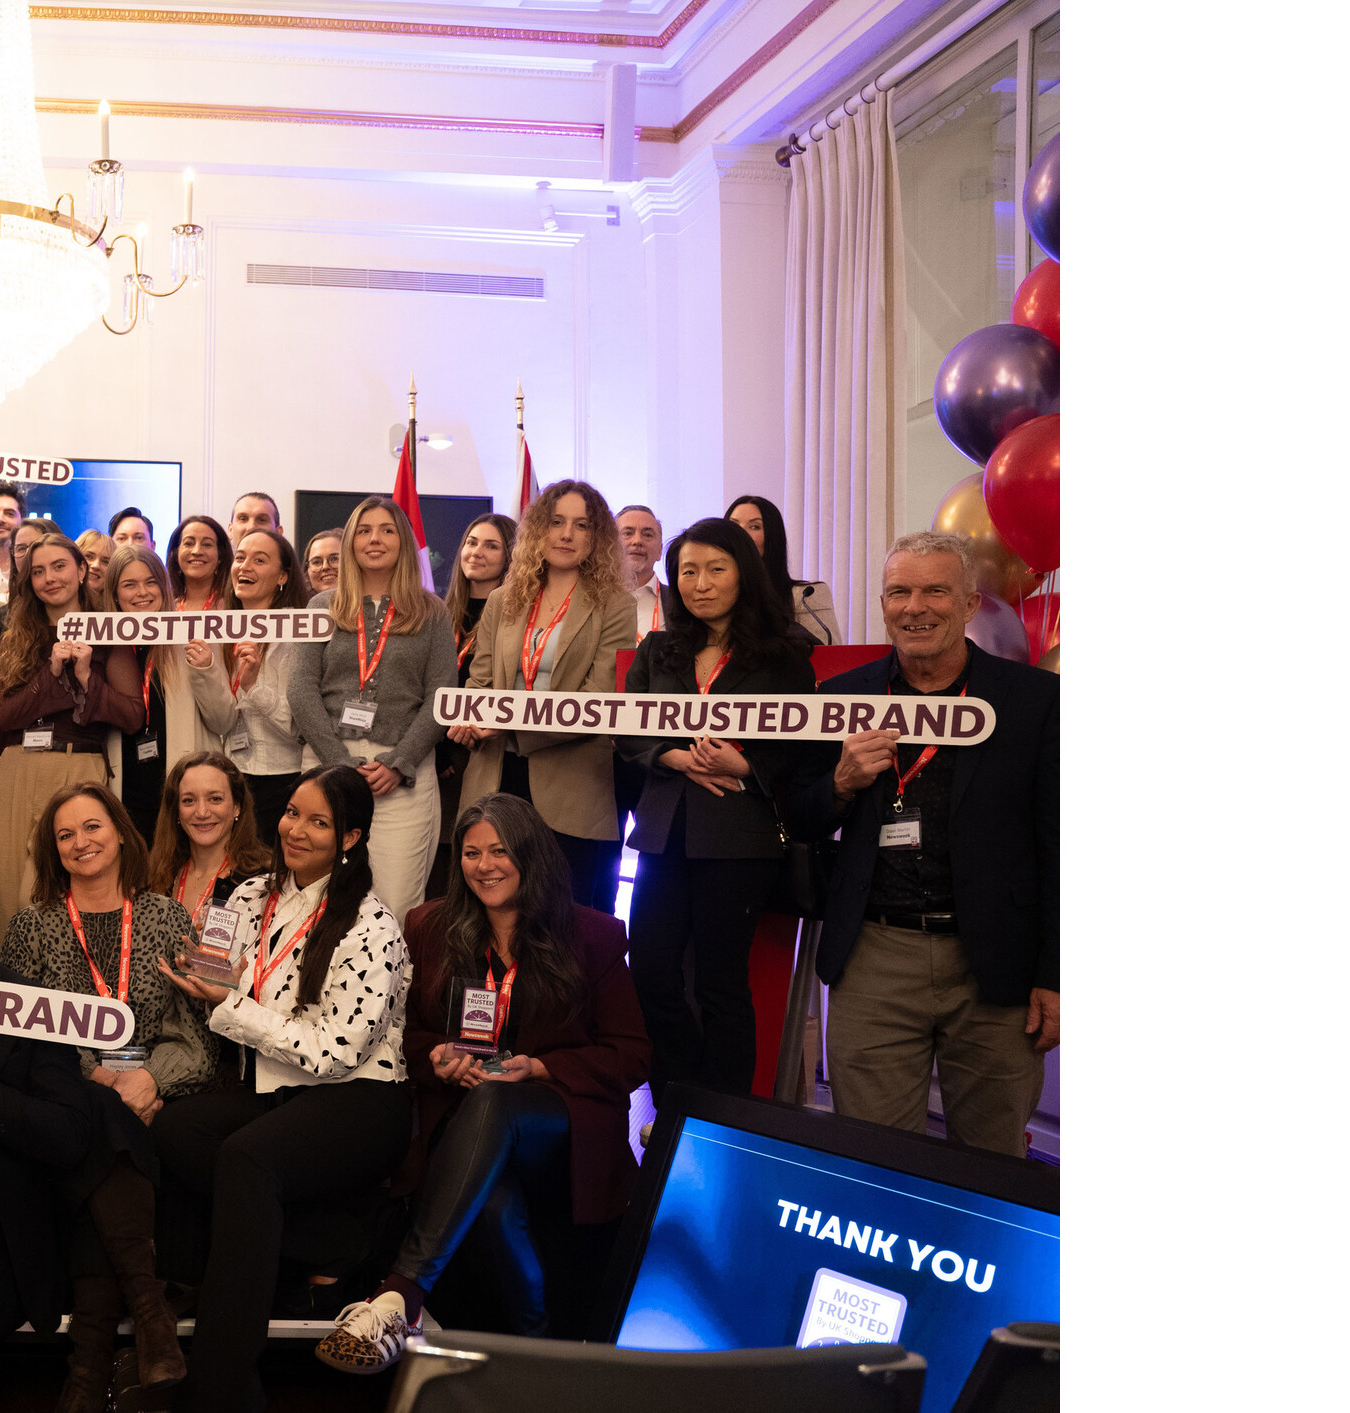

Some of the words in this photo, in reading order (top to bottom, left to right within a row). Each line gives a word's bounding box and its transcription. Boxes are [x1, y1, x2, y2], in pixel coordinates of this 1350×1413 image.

[61, 613, 335, 641] #MOSTTRUSTED
[438, 694, 514, 724] UK'S
[522, 697, 627, 730] MOST
[634, 700, 809, 734] TRUSTED
[820, 702, 986, 738] BRAND
[208, 916, 235, 926] TRUSTED
[214, 910, 232, 920] MOST
[467, 998, 494, 1006] TRUSTED
[778, 1199, 899, 1263] THANK
[907, 1239, 996, 1293] YOU
[832, 1288, 880, 1315] MOST
[816, 1316, 828, 1328] By
[828, 1321, 842, 1333] UK
[817, 1299, 889, 1336] TRUSTED
